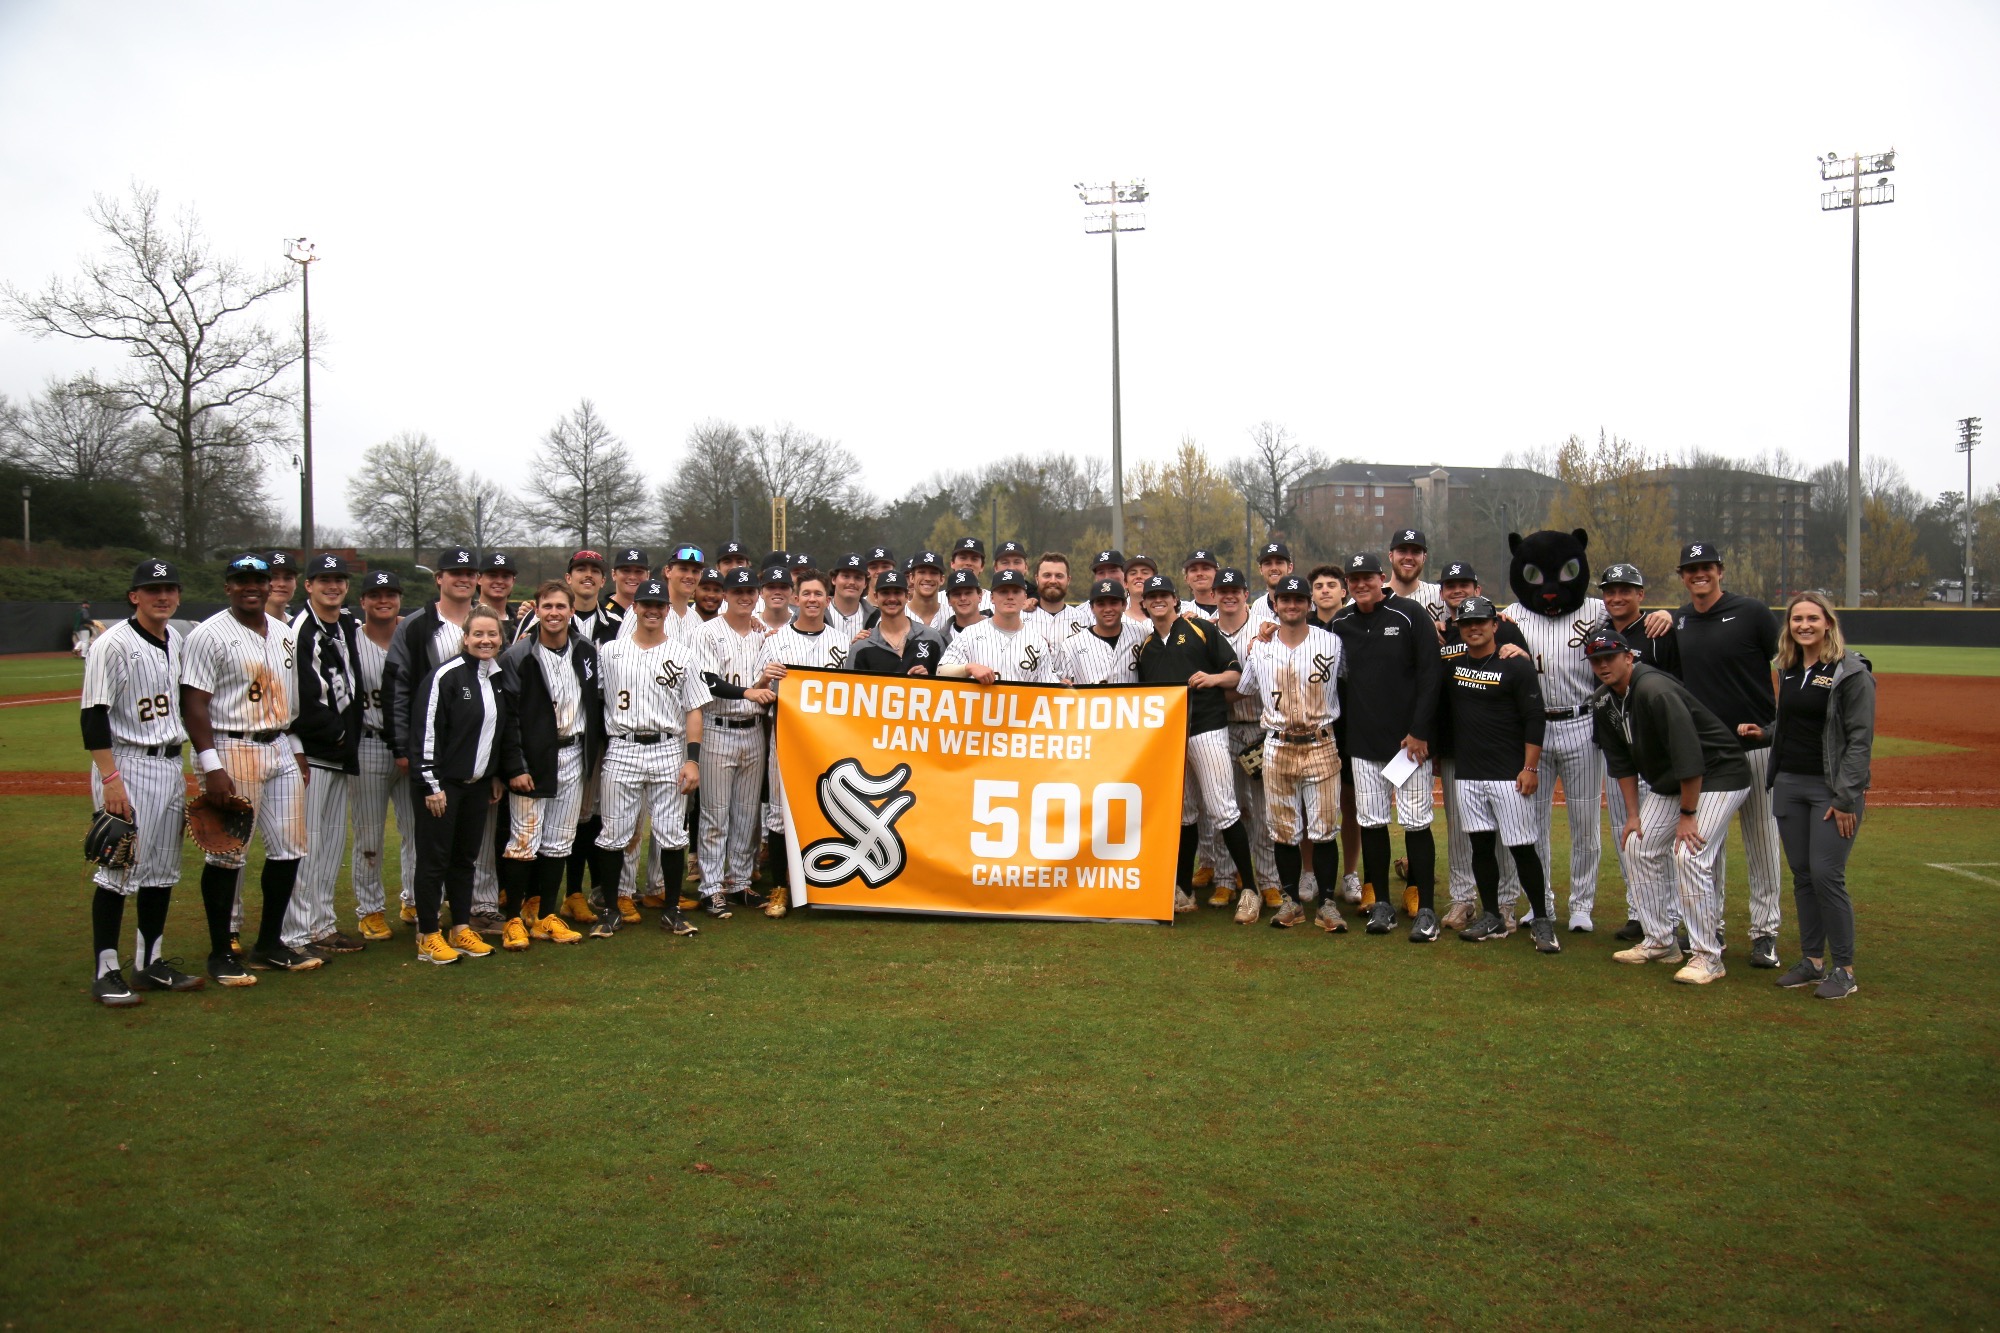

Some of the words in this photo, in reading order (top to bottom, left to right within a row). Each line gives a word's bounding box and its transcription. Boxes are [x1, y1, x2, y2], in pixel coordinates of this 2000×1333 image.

[1455, 666, 1502, 681] SOUTHERN
[1457, 680, 1486, 690] BASEBALL
[248, 681, 262, 702] 8
[618, 690, 630, 710] 3
[1271, 691, 1282, 711] 7
[138, 694, 169, 722] 29
[799, 679, 1166, 730] CONGRATULATIONS
[872, 725, 929, 752] JAN
[939, 730, 1092, 760] WEISBERG!
[970, 779, 1142, 861] 500
[972, 864, 1068, 887] CAREER
[1076, 867, 1141, 890] WINS
